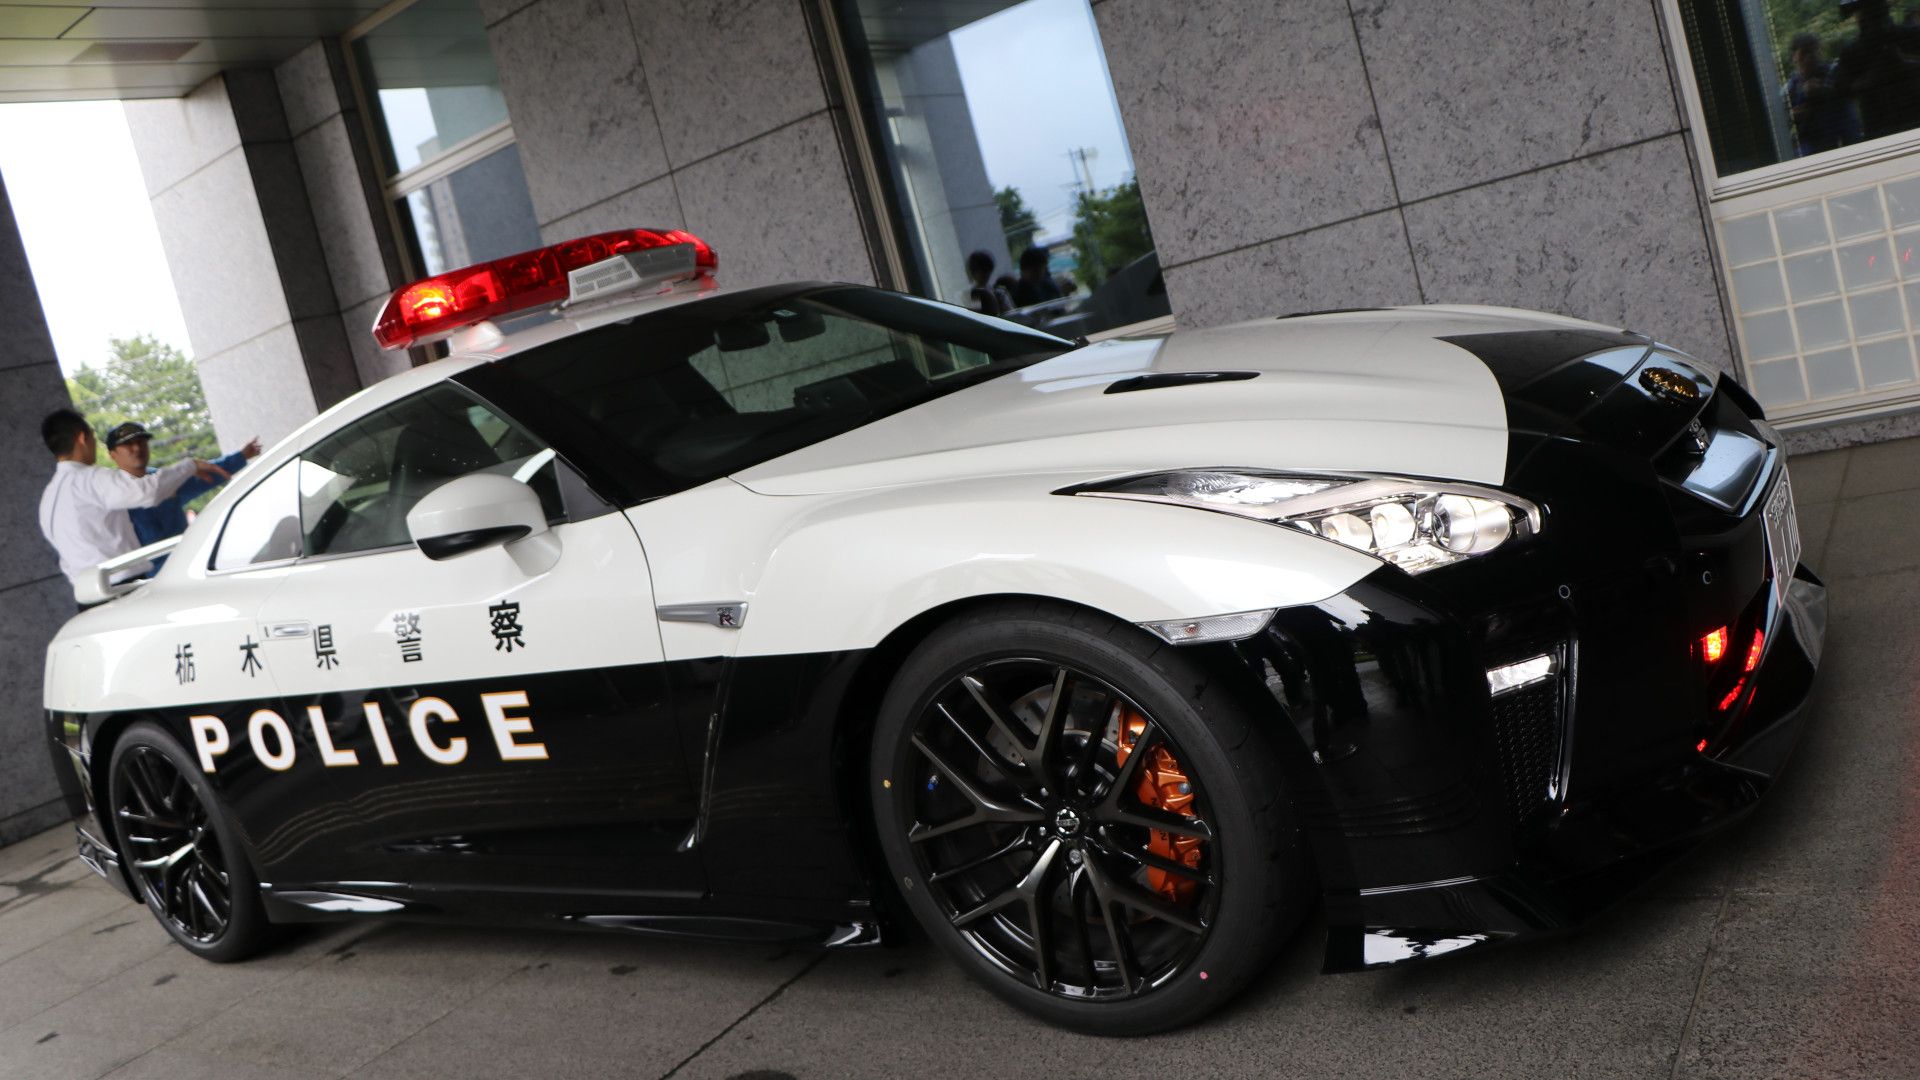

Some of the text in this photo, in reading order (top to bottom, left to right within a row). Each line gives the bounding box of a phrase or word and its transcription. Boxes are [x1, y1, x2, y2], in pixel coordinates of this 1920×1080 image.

[174, 599, 526, 686] 栃木県警察
[188, 689, 550, 774] POLICE
